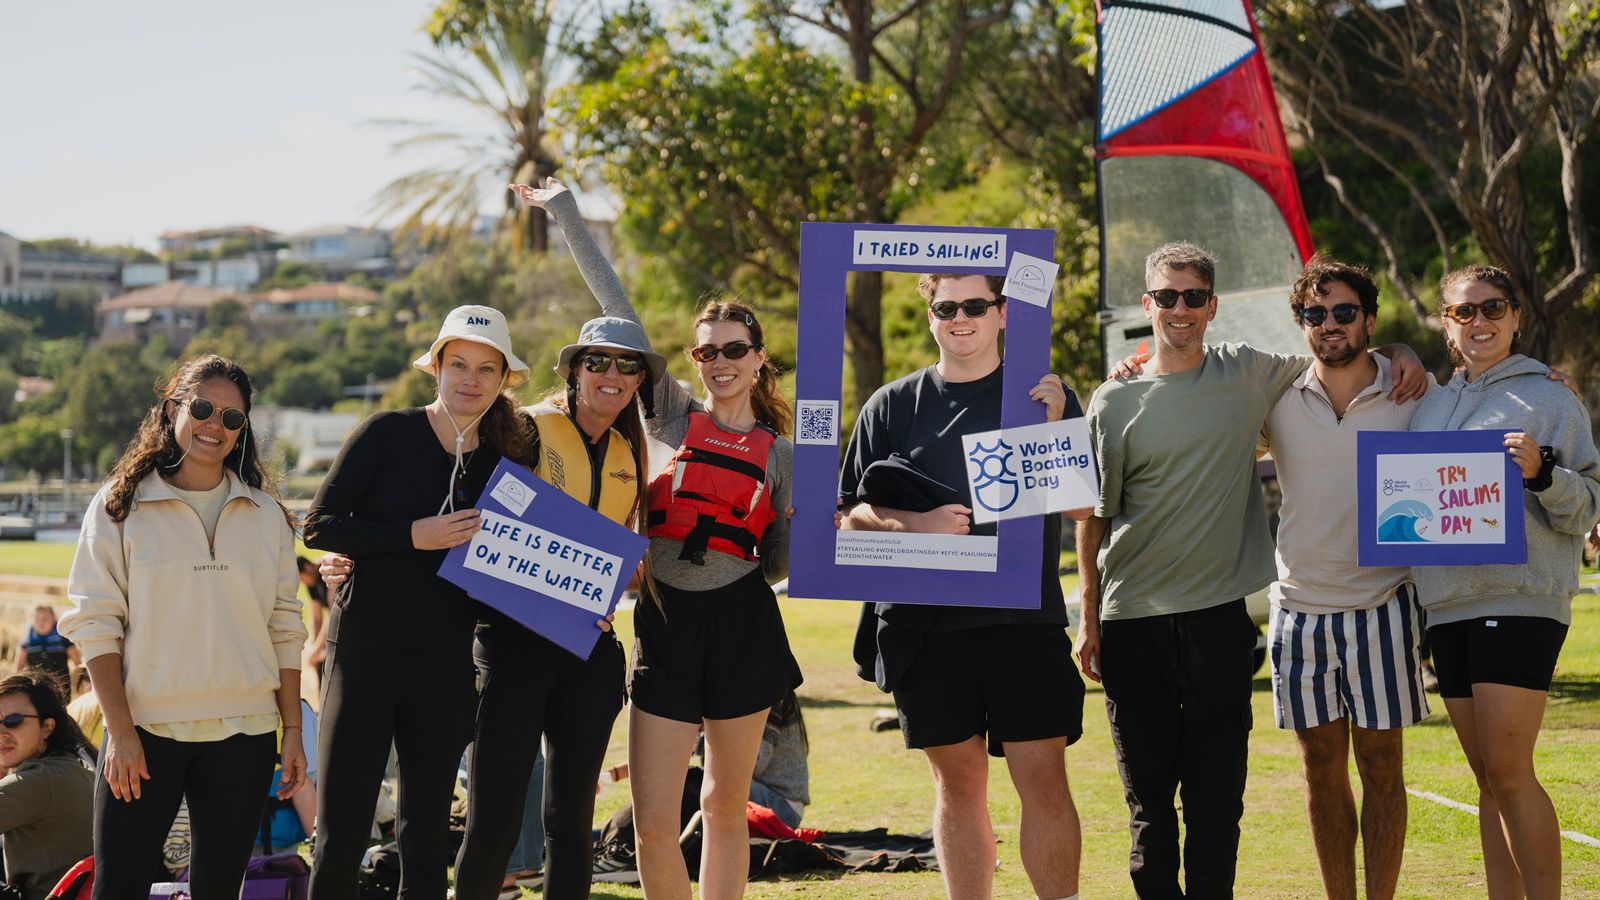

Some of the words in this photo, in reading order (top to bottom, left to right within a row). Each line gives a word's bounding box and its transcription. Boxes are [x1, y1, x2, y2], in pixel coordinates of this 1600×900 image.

[858, 242, 863, 256] I
[870, 241, 920, 258] TRIED
[926, 240, 999, 260] SAILING!
[466, 316, 492, 326] ANF
[1019, 436, 1072, 457] World
[1021, 454, 1089, 474] Boating
[1024, 475, 1060, 489] Day
[1436, 465, 1467, 486] TRY
[1438, 482, 1500, 511] SAILING
[1441, 515, 1472, 535] DAY
[481, 518, 522, 542] LIFE
[525, 533, 541, 550] IS
[547, 540, 614, 576] BETTER
[837, 553, 893, 561] #LIFEONTHEWATER
[876, 547, 940, 556] #WORLDBOATINGDAY
[475, 544, 501, 565] ON
[507, 555, 541, 577] THE
[544, 569, 603, 602] WATER
